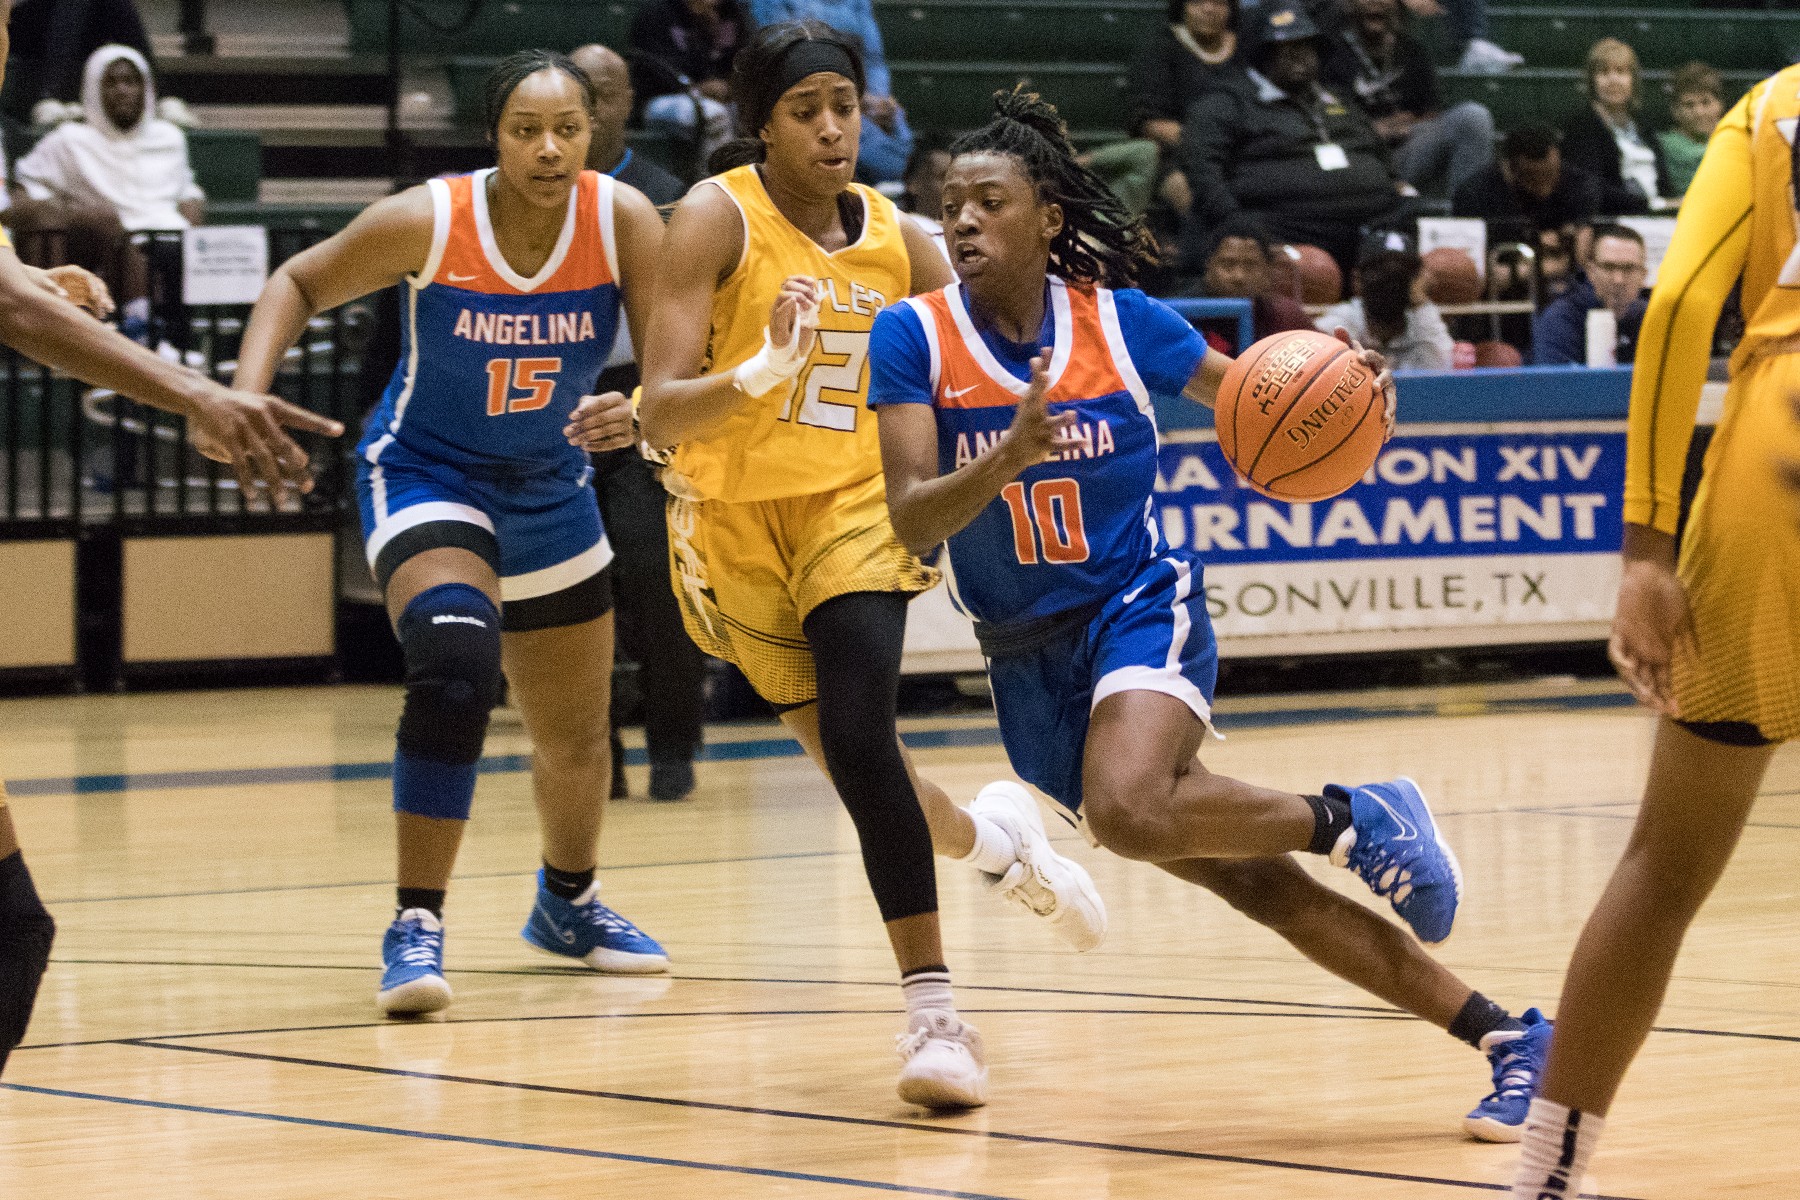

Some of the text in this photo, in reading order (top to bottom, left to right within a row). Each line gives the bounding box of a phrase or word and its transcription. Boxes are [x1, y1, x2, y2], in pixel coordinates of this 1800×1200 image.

[817, 277, 886, 319] LER
[453, 308, 596, 345] ANGELINA
[486, 357, 562, 416] 15
[1259, 340, 1326, 416] LEGACY
[1286, 359, 1367, 450] SPALDING
[955, 419, 1115, 469] ANINA
[1497, 445, 1602, 482] XIV
[1001, 477, 1090, 565] 10
[1492, 571, 1547, 606] TX
